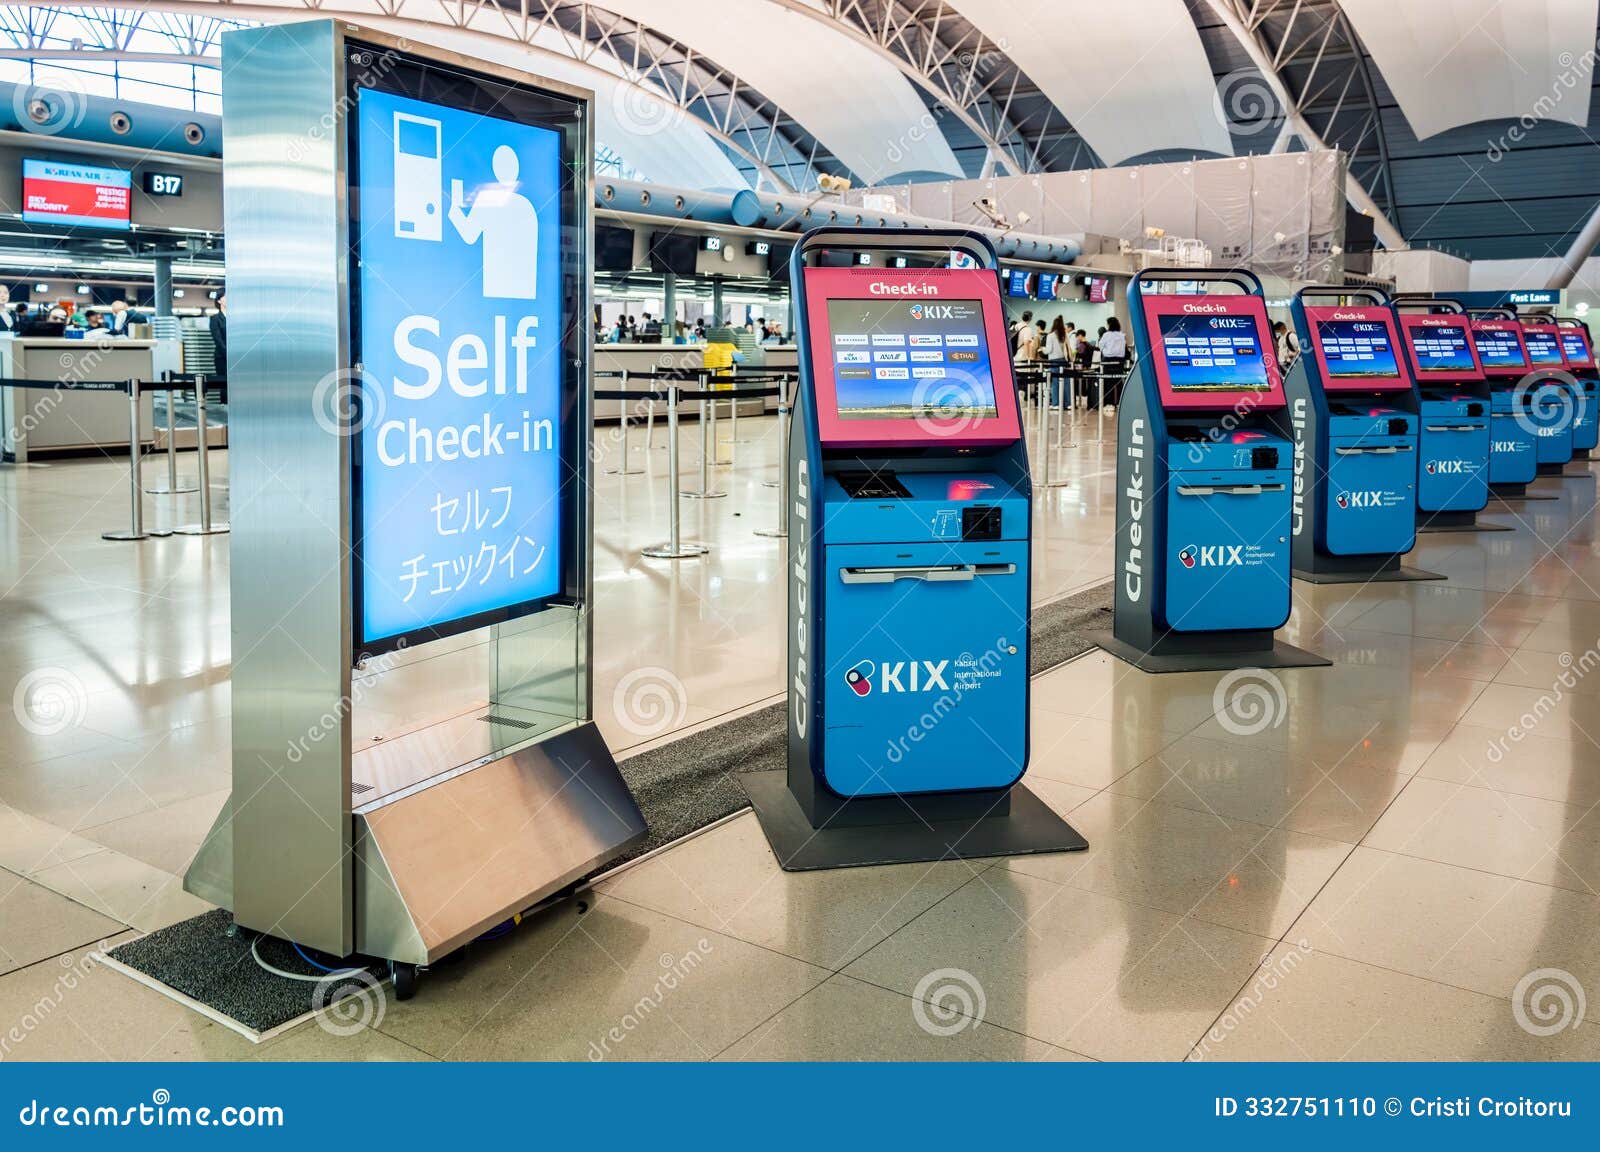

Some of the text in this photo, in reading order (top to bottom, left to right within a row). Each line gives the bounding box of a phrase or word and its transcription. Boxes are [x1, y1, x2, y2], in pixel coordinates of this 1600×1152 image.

[153, 175, 181, 194] B17
[28, 203, 69, 212] PRIORITY
[869, 282, 938, 295] Check-in
[1510, 294, 1550, 302] Fast Lane
[924, 305, 954, 319] KIX
[1183, 304, 1227, 313] Check-in
[1219, 319, 1238, 328] KIX
[1359, 323, 1374, 331] KIX
[393, 315, 539, 400] Self
[376, 410, 553, 467] Check-in
[1495, 441, 1515, 452] KIX
[1438, 461, 1462, 473] KIX
[1351, 491, 1382, 507] KIX
[430, 486, 512, 536] セルフ
[1126, 418, 1144, 602] Check-in
[1201, 545, 1242, 566] KIX
[399, 535, 545, 603] チェックイン
[795, 459, 807, 739] Check-in
[955, 659, 978, 667] Kansai
[881, 659, 950, 693] KIX
[954, 668, 1002, 678] International
[953, 682, 982, 691] Airport
